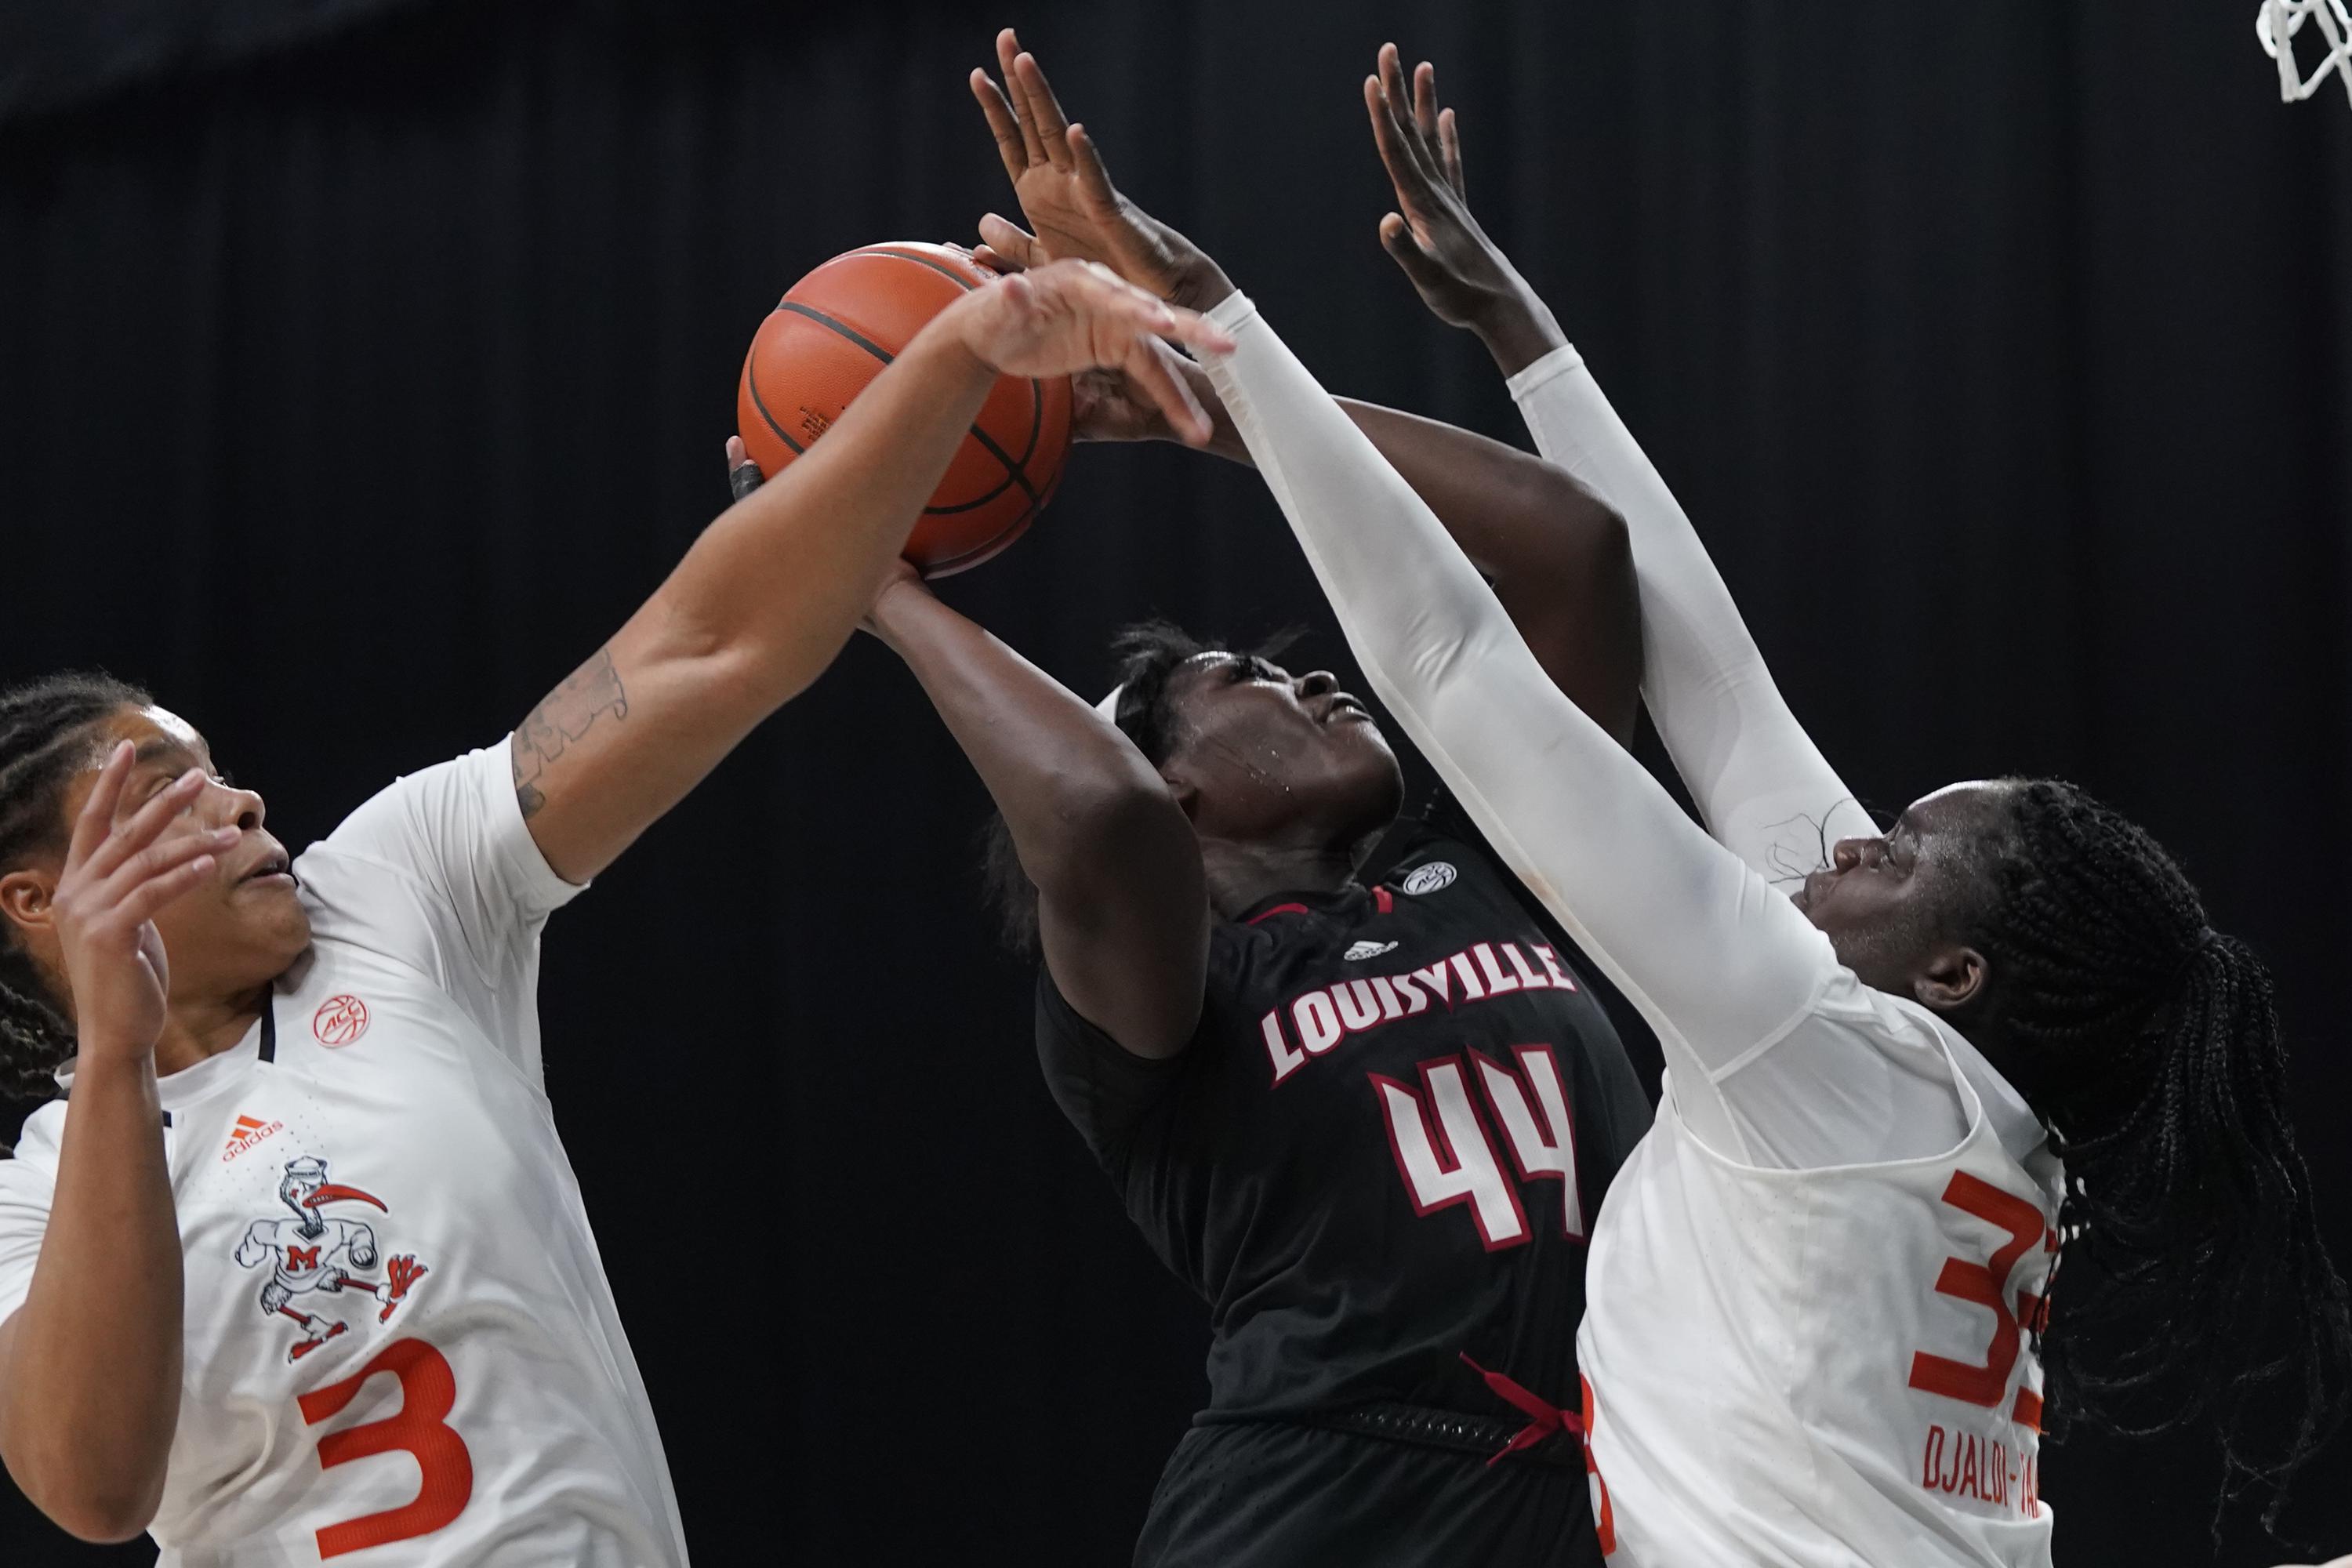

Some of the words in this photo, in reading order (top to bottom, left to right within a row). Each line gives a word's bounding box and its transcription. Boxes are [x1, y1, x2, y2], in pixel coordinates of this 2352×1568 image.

[1260, 942, 1578, 1090] LOUISVILLE
[223, 1120, 283, 1161] adidas
[1367, 1043, 1585, 1253] 44
[286, 1246, 321, 1271] M
[297, 1337, 474, 1561] 3
